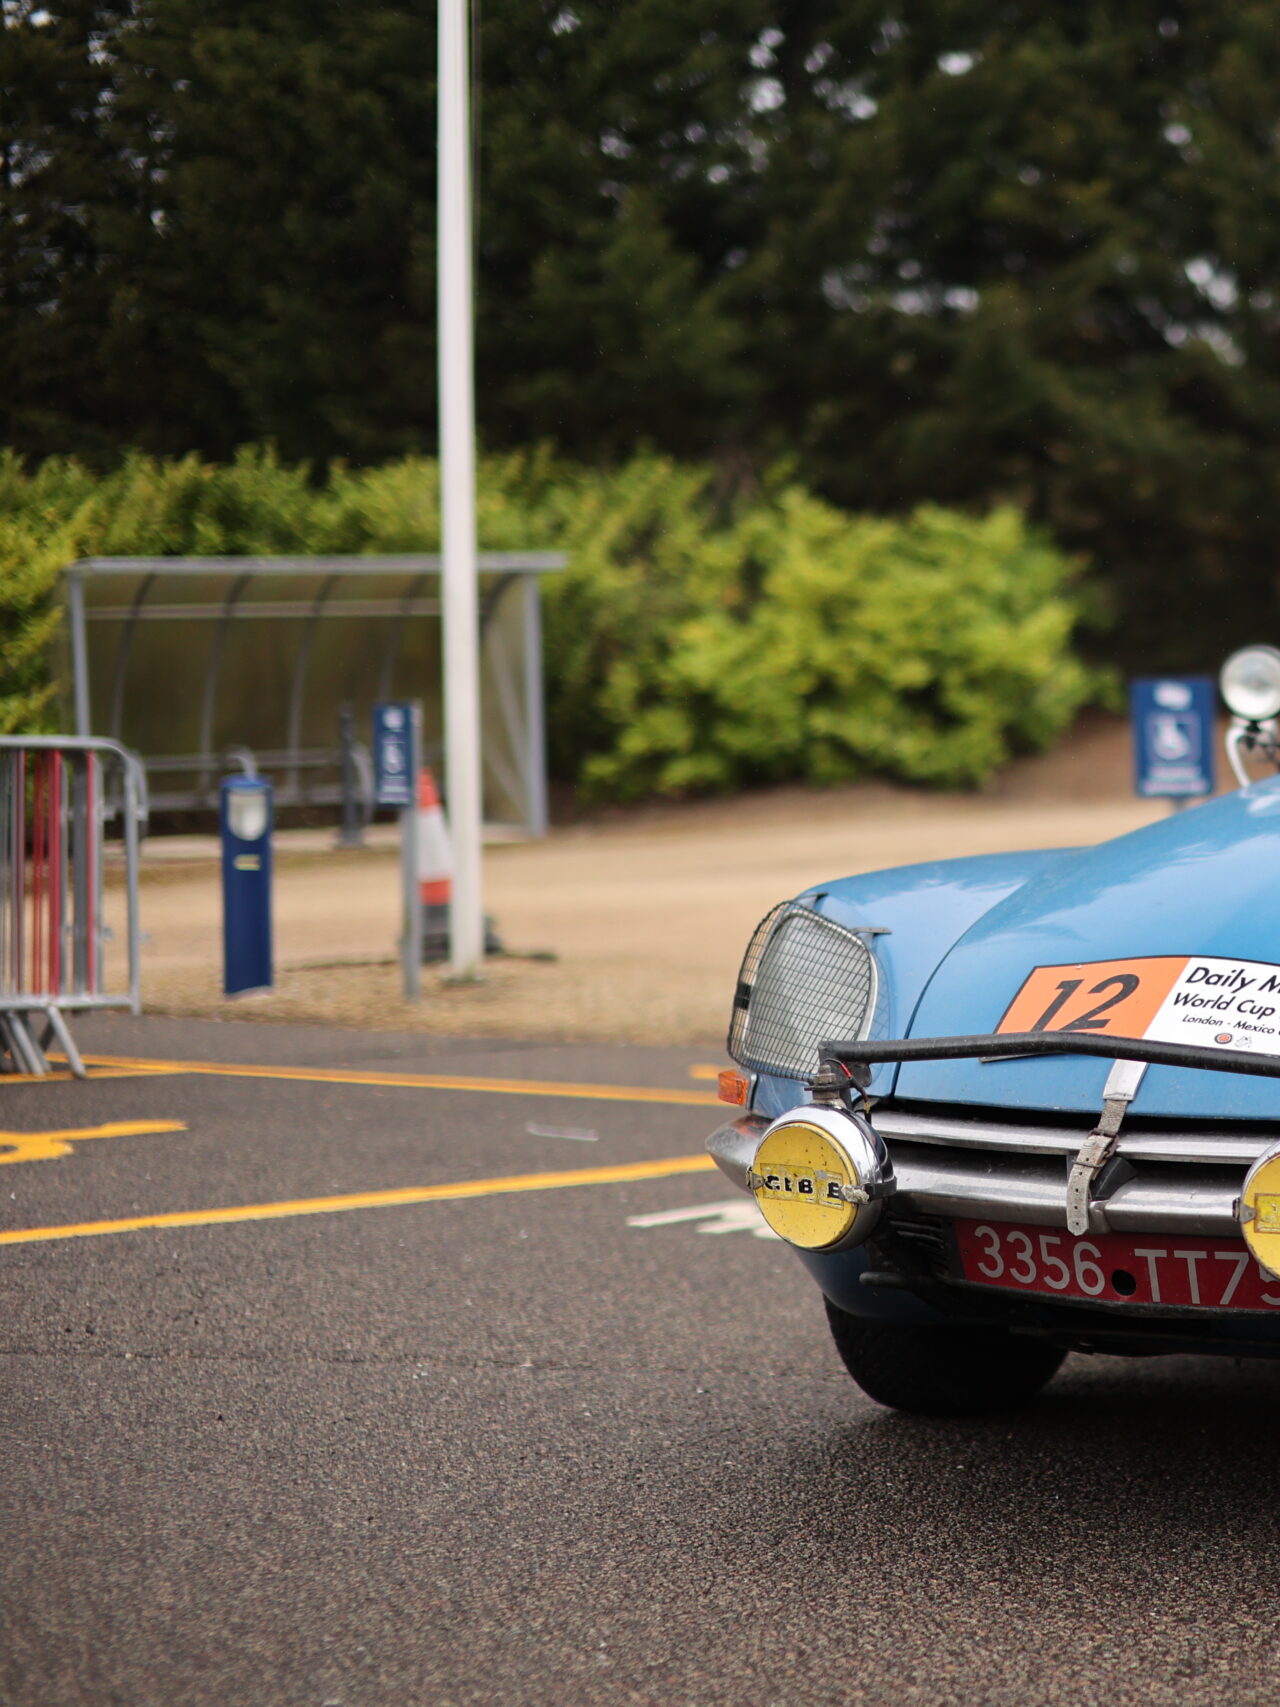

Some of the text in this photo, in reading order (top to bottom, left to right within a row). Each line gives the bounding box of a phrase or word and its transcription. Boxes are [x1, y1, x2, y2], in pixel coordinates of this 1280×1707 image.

[1185, 967, 1256, 993] Daily
[1028, 973, 1140, 1033] 12
[1173, 992, 1236, 1010] World
[1236, 1000, 1276, 1020] Cup
[1182, 1014, 1223, 1026] London
[1233, 1021, 1275, 1035] Mexico
[974, 1225, 1105, 1295] 3356
